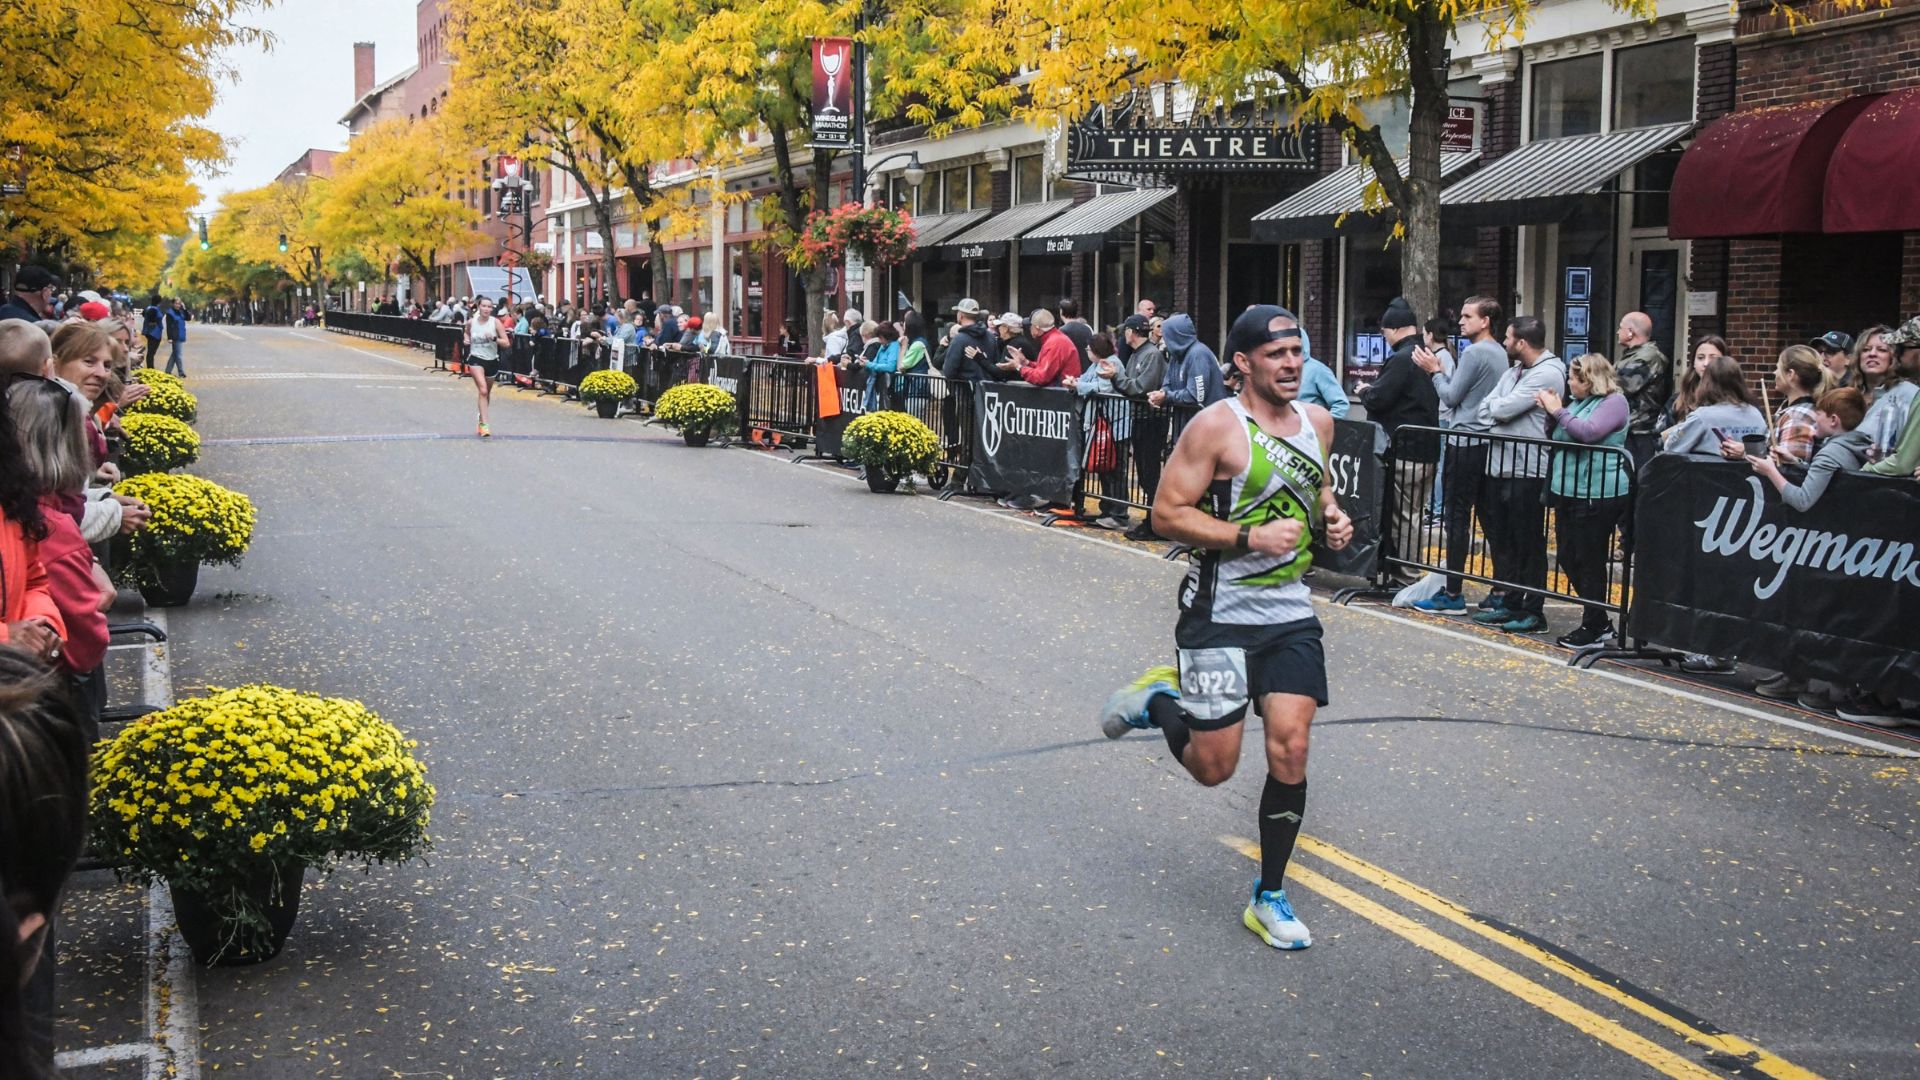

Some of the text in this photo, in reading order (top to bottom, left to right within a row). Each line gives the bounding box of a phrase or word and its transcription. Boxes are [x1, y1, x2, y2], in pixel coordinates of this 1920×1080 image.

[1449, 107, 1465, 118] ICE
[815, 121, 847, 129] MARATHON
[1108, 136, 1267, 157] THEATRE
[961, 244, 984, 258] the cellar
[1047, 238, 1074, 252] the cellar
[840, 387, 867, 415] NEGLA
[1329, 453, 1351, 495] SS
[1182, 552, 1202, 609] RUN
[1188, 669, 1237, 695] 3922
